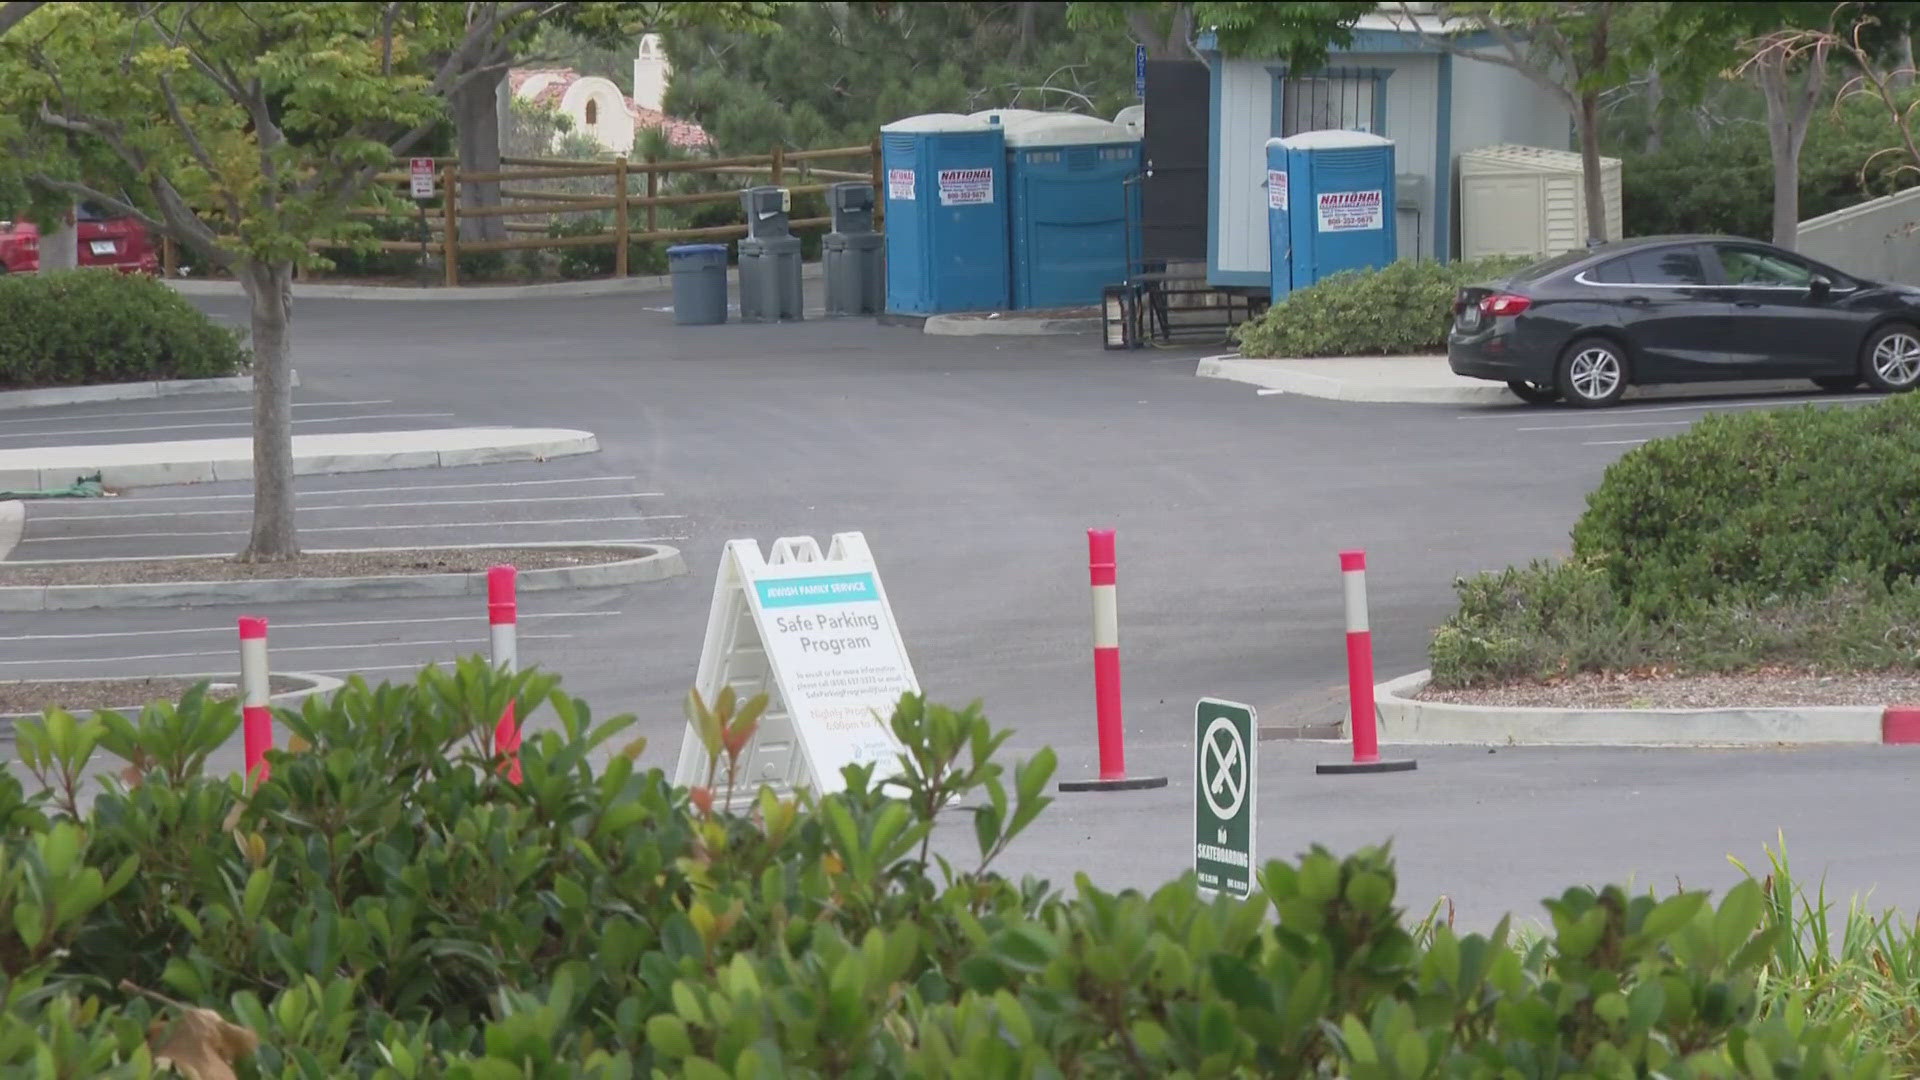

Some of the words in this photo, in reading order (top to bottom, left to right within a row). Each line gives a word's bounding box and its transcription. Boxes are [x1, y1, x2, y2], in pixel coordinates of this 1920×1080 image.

[941, 171, 991, 181] NATIONAL
[1320, 192, 1380, 205] NATIONAL
[767, 586, 800, 598] JEWISH
[799, 583, 830, 595] FAMILY
[830, 582, 867, 593] SERVICE
[776, 614, 814, 633] Safe
[816, 611, 880, 631] Parking
[800, 636, 872, 655] Program
[1197, 843, 1248, 868] SKATEBOARDING
